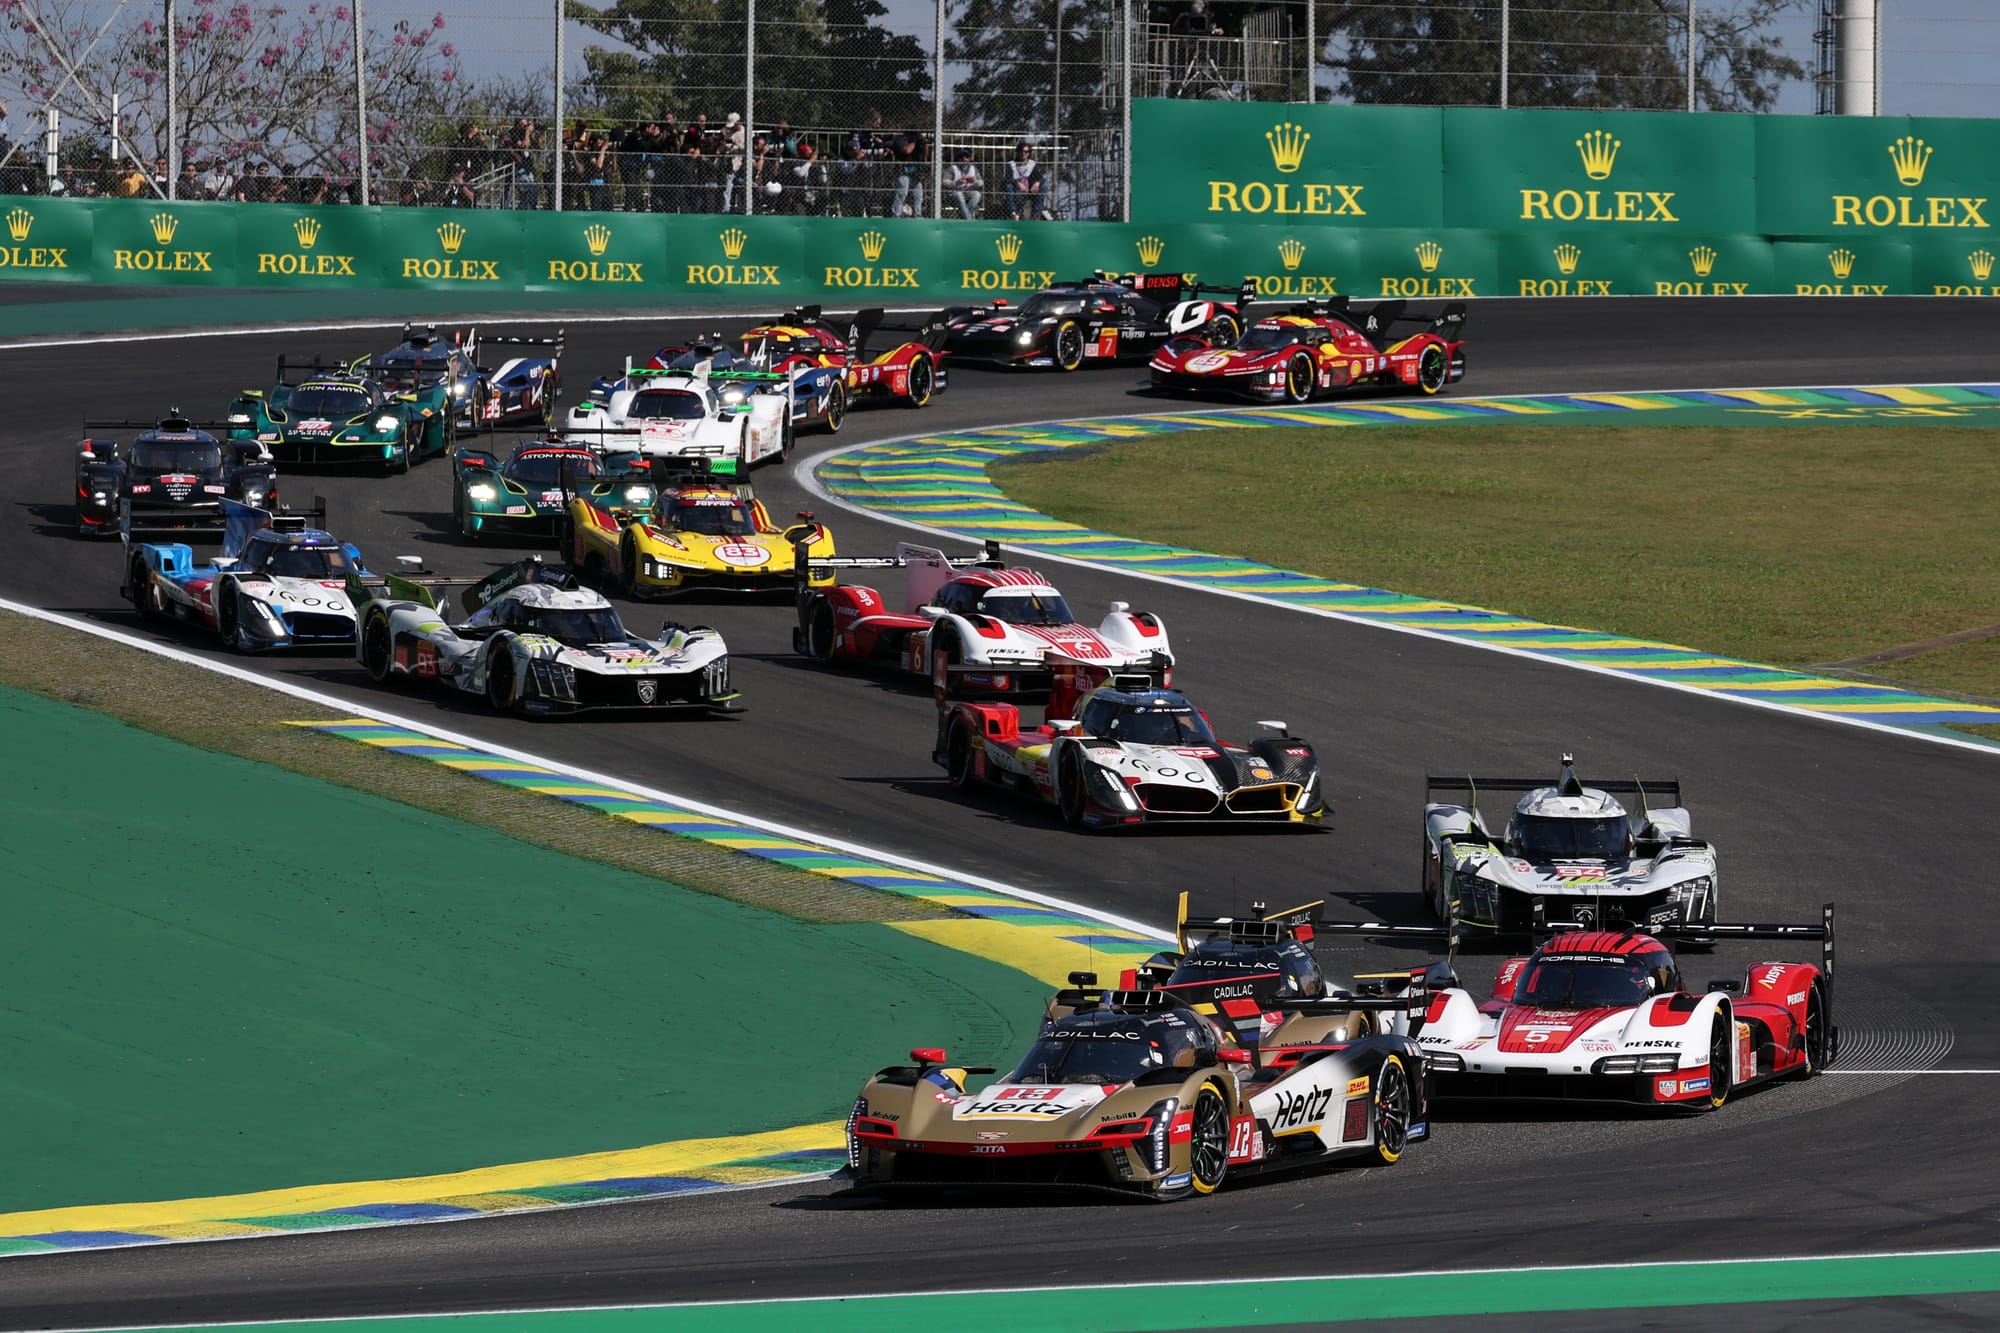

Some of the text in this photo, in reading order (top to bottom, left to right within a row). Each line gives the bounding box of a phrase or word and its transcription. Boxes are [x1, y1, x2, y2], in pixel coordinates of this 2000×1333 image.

[1209, 181, 1366, 215] ROLEX
[1520, 189, 1680, 222] ROLEX
[1833, 195, 1990, 228] ROLEX
[0, 246, 68, 268] OLEX
[114, 249, 212, 272] ROLEX
[258, 253, 355, 276] ROLEX
[402, 258, 499, 280] ROLEX
[547, 260, 643, 282] ROLEX
[686, 264, 781, 286] ROLEX
[824, 266, 920, 288] ROLEX
[960, 269, 1056, 290] ROLEX
[1147, 276, 1179, 289] DENSO
[1242, 284, 1255, 292] JFE
[1243, 275, 1337, 296] ROLEX
[1381, 277, 1476, 298] ROLEX
[1519, 279, 1612, 296] ROLEX
[1104, 338, 1113, 355] 7
[326, 385, 363, 395] MARTIN
[725, 547, 758, 557] 83
[904, 548, 940, 560] PORSCHE
[1074, 641, 1093, 651] 6
[418, 652, 436, 674] 93
[913, 646, 922, 670] 6
[1559, 868, 1605, 877] 94
[1650, 908, 1678, 925] PORSCHE
[1183, 959, 1280, 970] CADILLAC
[1538, 955, 1626, 964] PORSCHE
[1758, 965, 1786, 990] Ansys
[1213, 984, 1254, 999] CADILLAC
[1786, 990, 1806, 1006] PENSKE
[1040, 1030, 1141, 1040] CADILLAC
[1416, 1036, 1453, 1045] NSKE
[1524, 1030, 1551, 1043] 5
[1624, 1040, 1684, 1049] PENSKE
[1349, 1080, 1366, 1092] DHL
[961, 1101, 1075, 1116] Hertz
[1271, 1084, 1333, 1130] Hertz
[1101, 1112, 1128, 1122] Mobil
[1174, 1123, 1191, 1134] JOTA
[1229, 1121, 1250, 1158] 12
[970, 1145, 1006, 1153] JOTA
